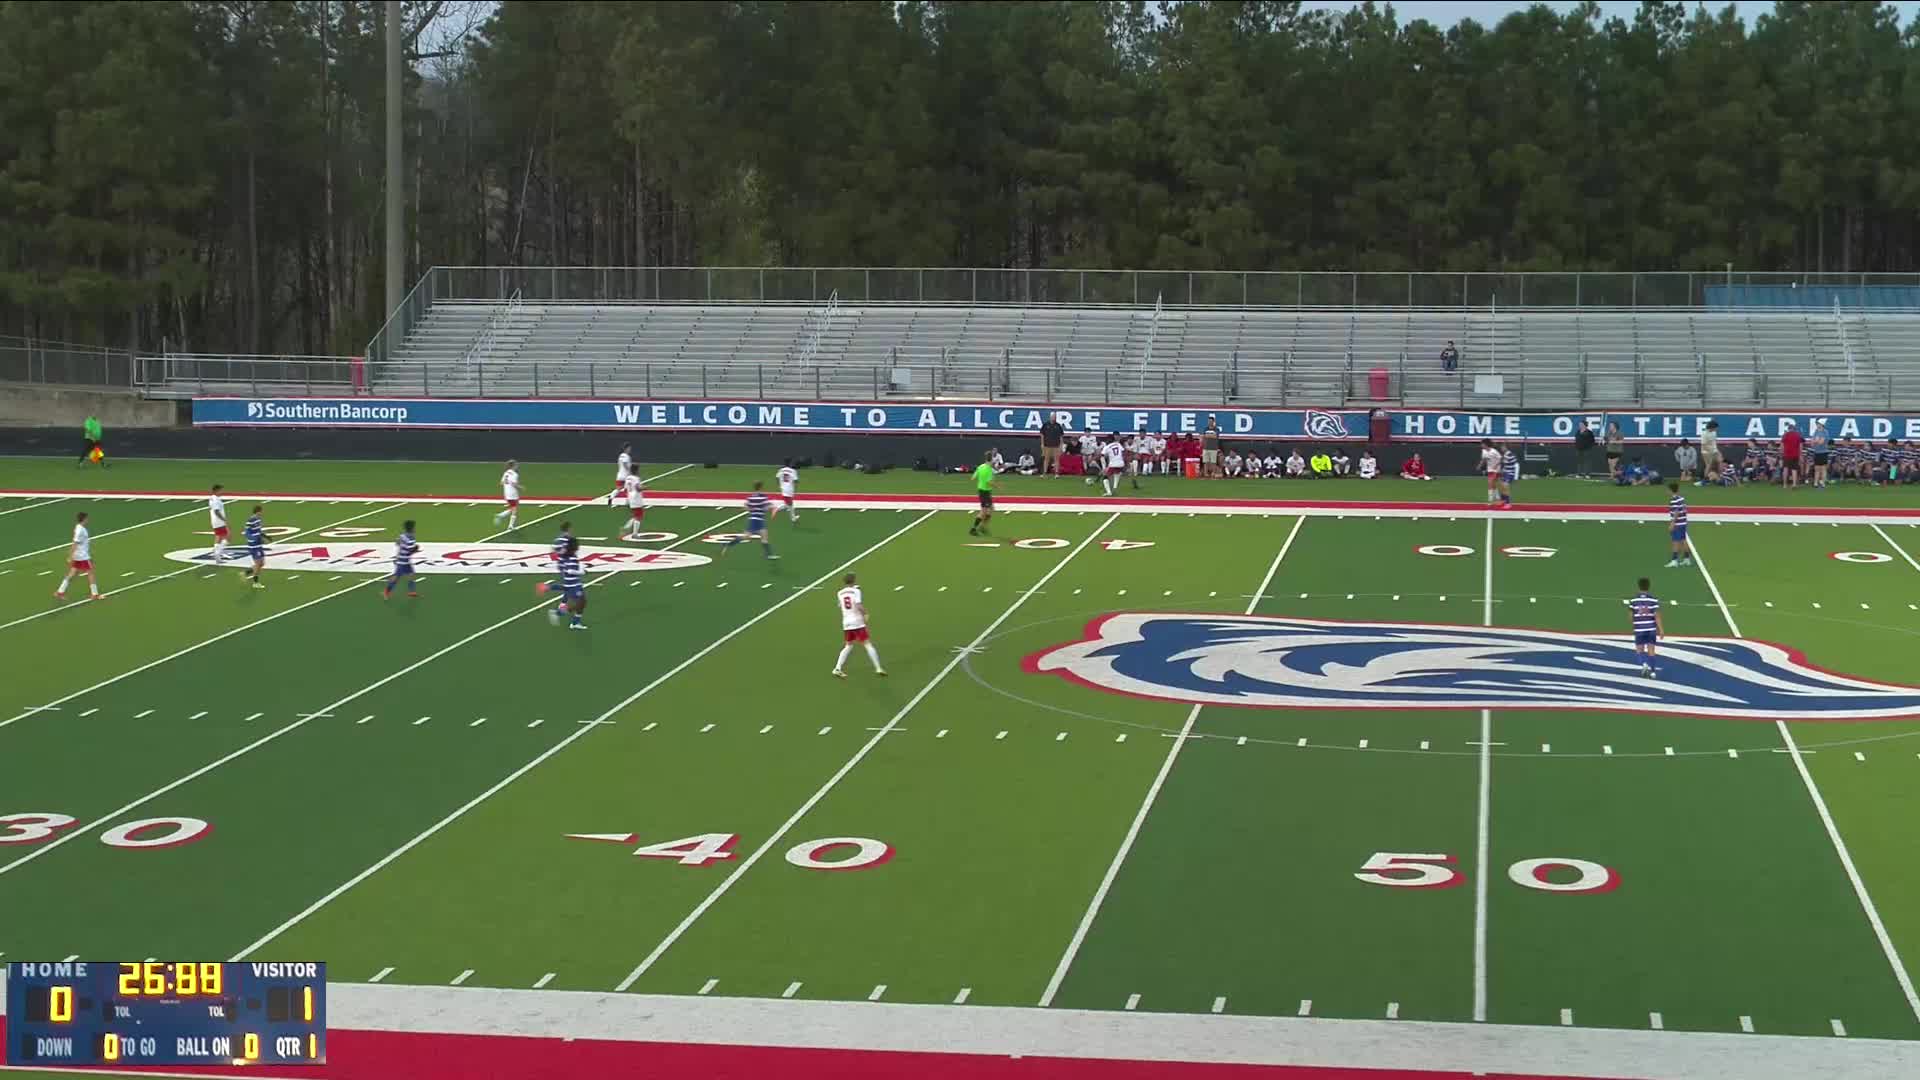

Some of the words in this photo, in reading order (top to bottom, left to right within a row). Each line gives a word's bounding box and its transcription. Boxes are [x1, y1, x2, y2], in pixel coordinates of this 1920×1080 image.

[613, 405, 810, 425] WELCOME
[840, 408, 887, 427] TO
[917, 408, 1101, 430] ALLCARE
[1133, 412, 1255, 433] FIED
[1405, 415, 1521, 435] HOME
